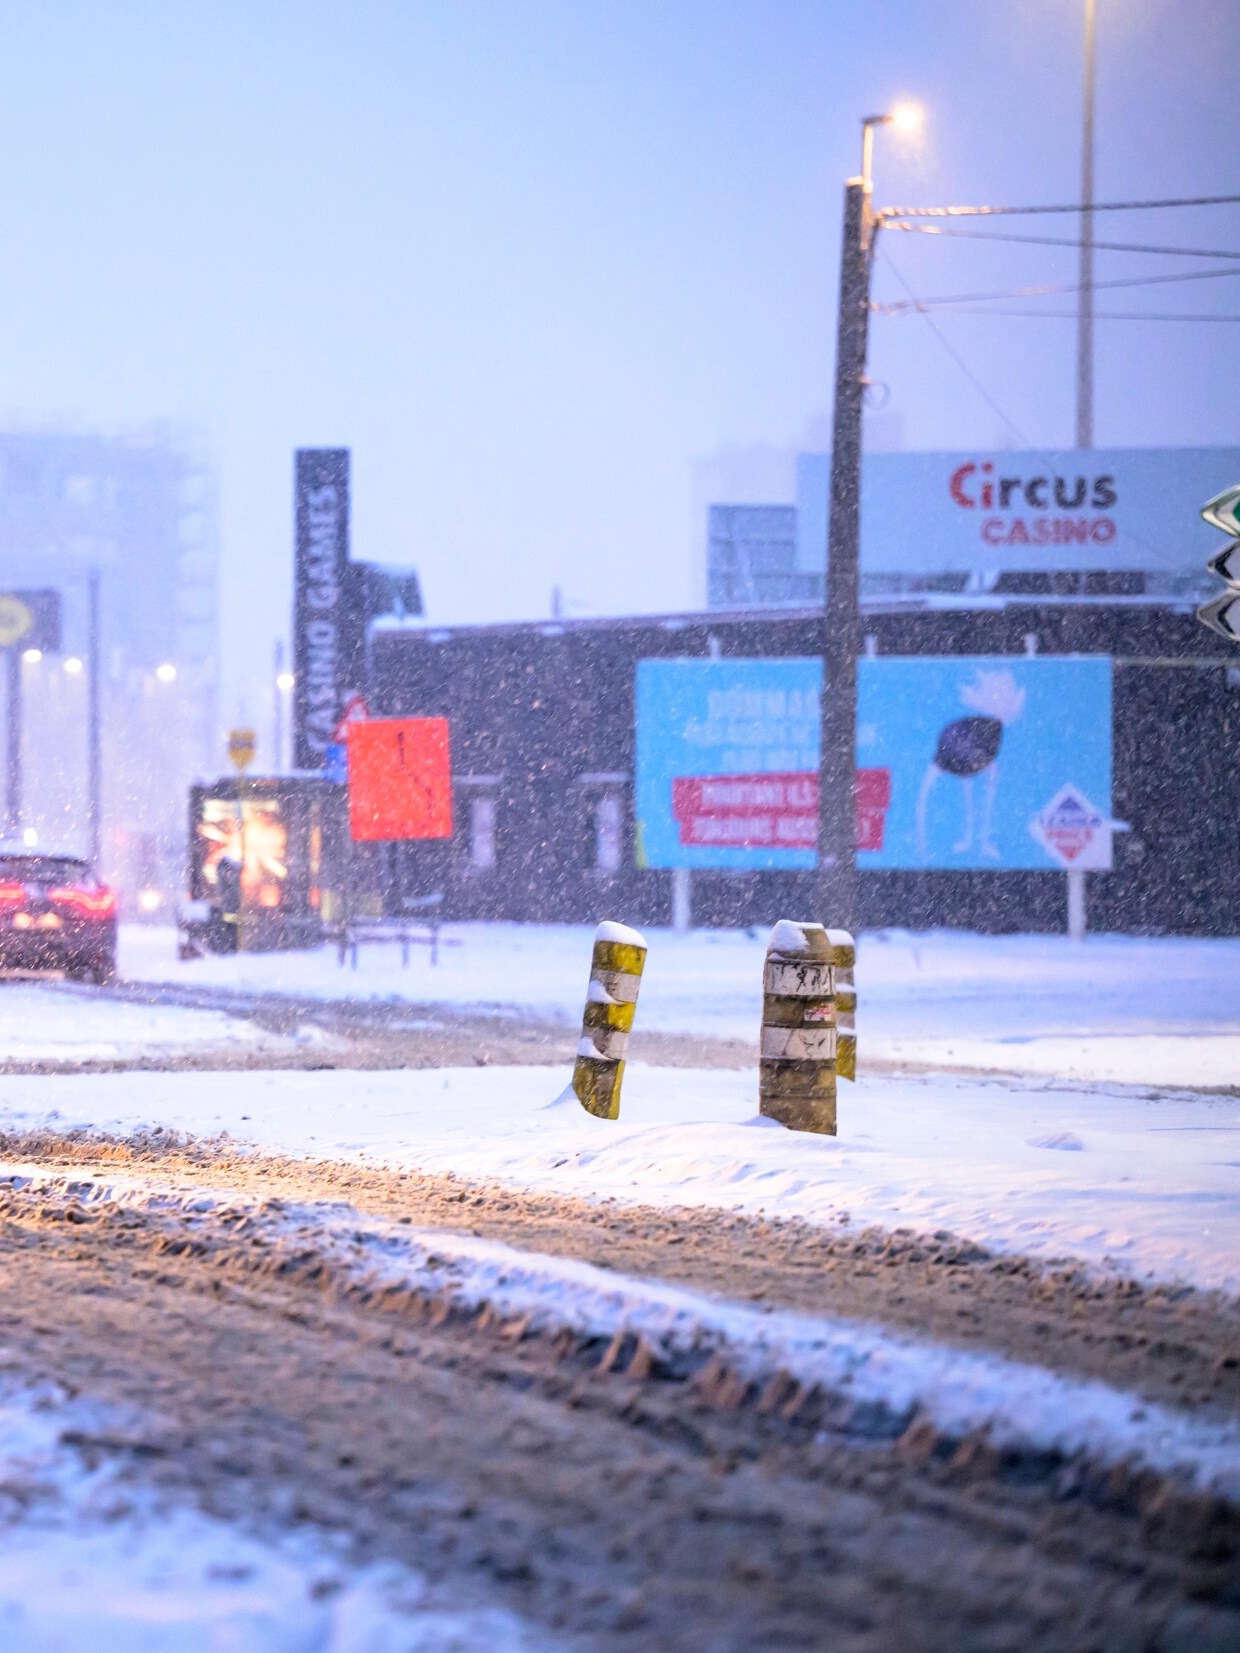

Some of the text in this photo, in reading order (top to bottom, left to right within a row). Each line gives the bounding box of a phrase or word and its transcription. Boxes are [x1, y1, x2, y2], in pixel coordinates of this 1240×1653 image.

[950, 462, 1117, 509] Circus
[307, 484, 339, 608] GAMES
[981, 517, 1117, 545] CASINO
